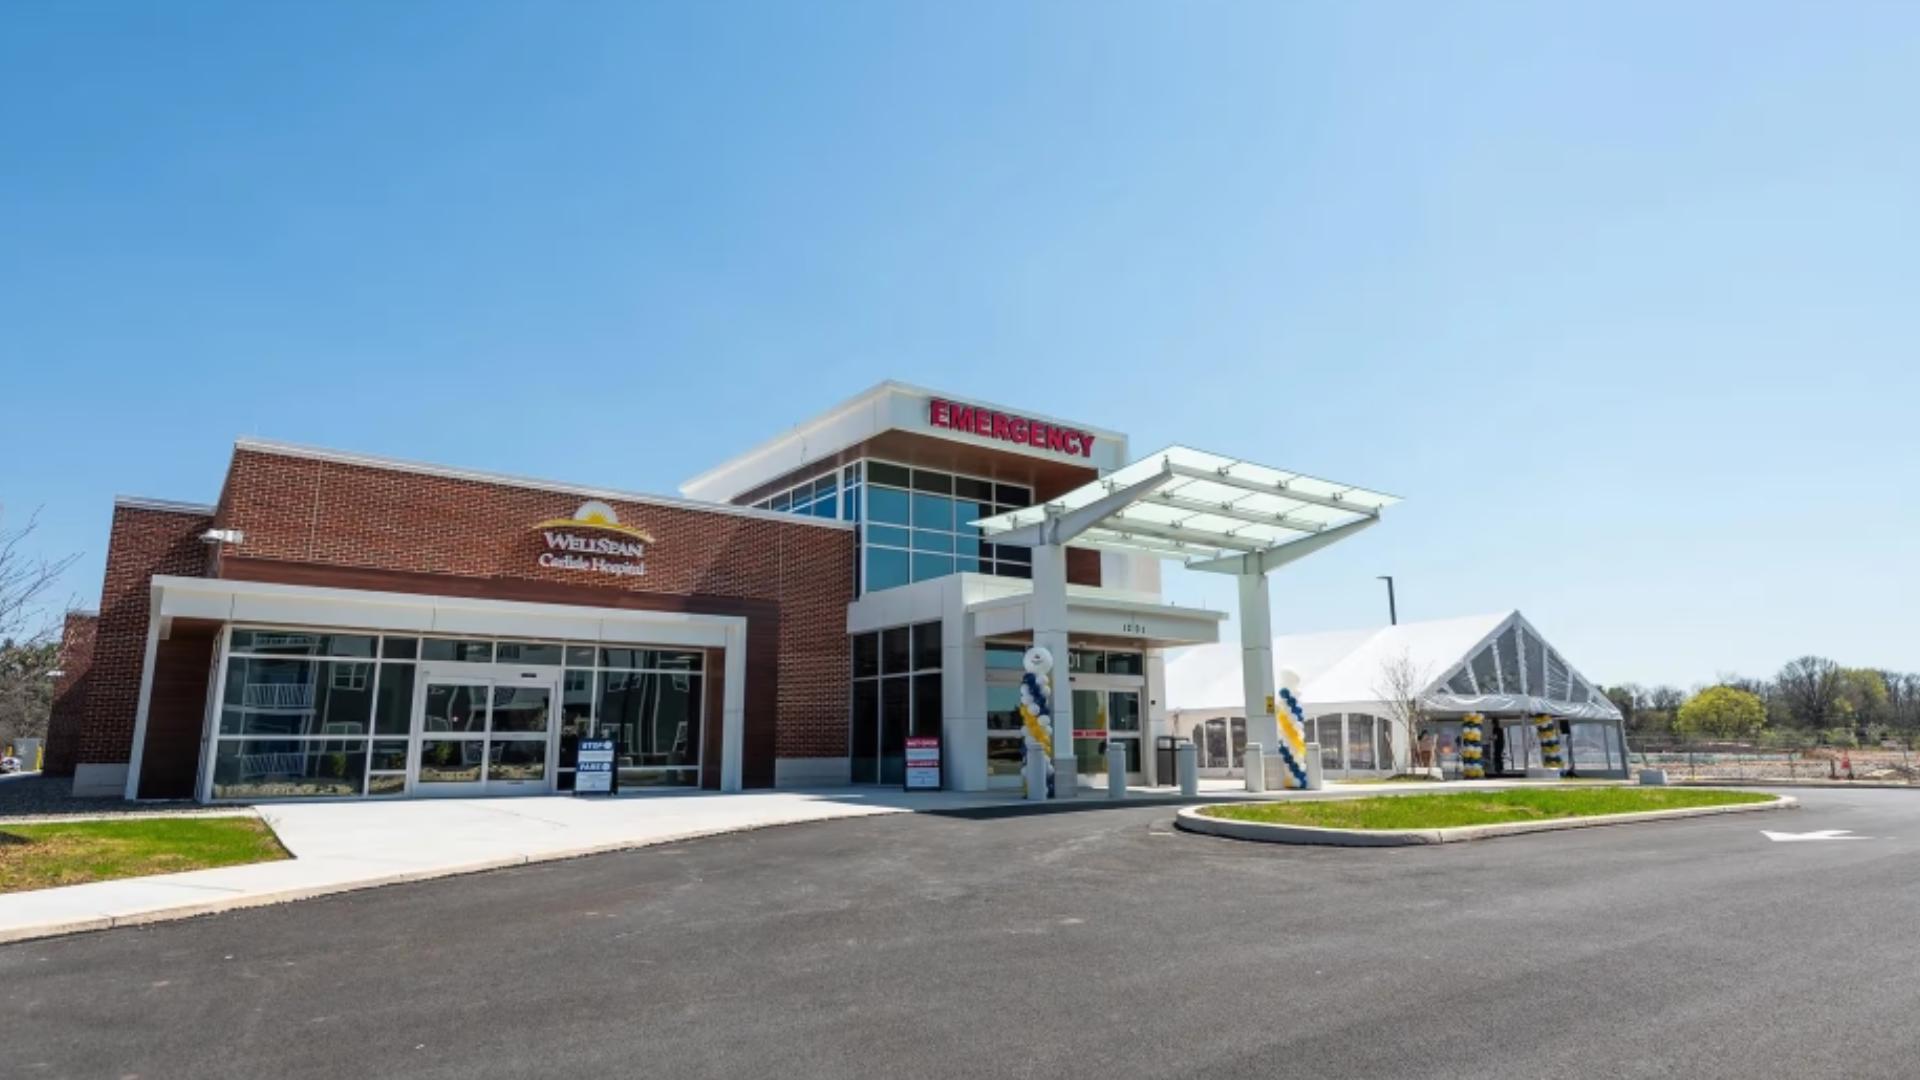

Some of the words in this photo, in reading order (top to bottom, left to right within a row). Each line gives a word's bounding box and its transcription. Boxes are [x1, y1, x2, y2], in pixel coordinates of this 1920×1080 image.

[930, 397, 1096, 457] EMERGENCY
[538, 553, 591, 572] Carlisle
[592, 557, 646, 577] Hospital
